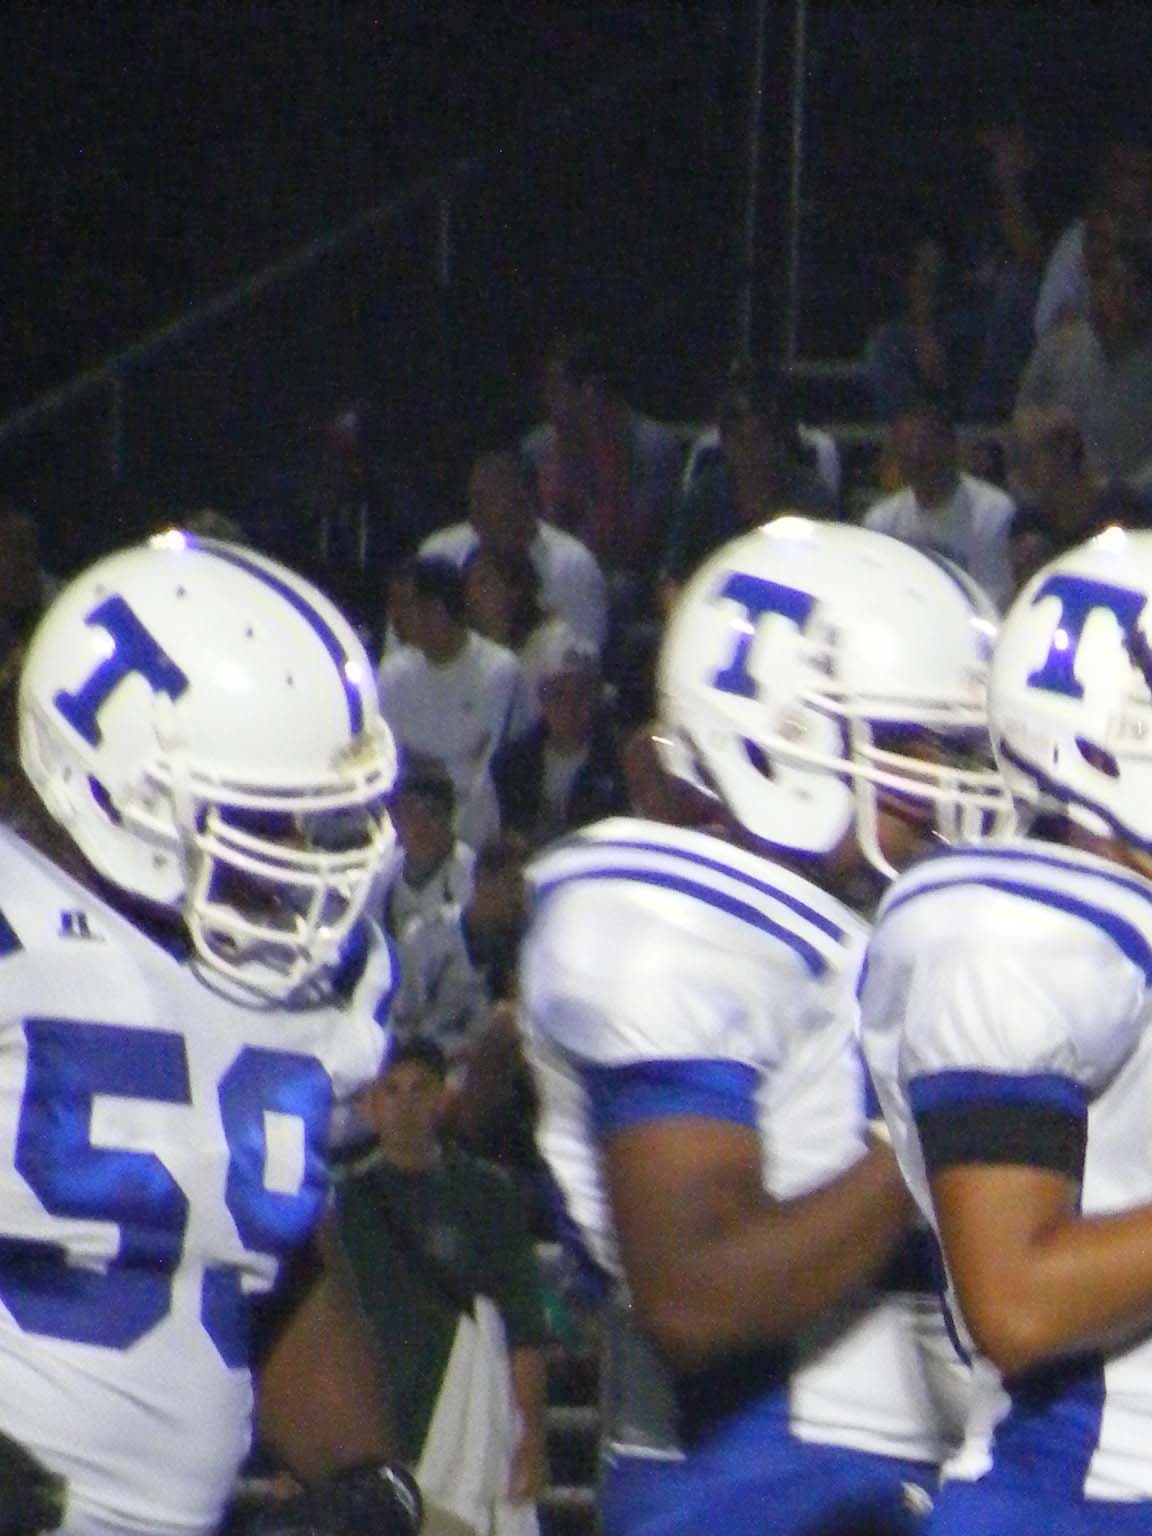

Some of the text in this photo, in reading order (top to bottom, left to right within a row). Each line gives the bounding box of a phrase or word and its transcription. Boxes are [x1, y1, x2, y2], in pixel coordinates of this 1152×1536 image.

[53, 593, 189, 748] T
[714, 571, 818, 701] T
[1028, 574, 1148, 699] T
[0, 1017, 336, 1370] 59
